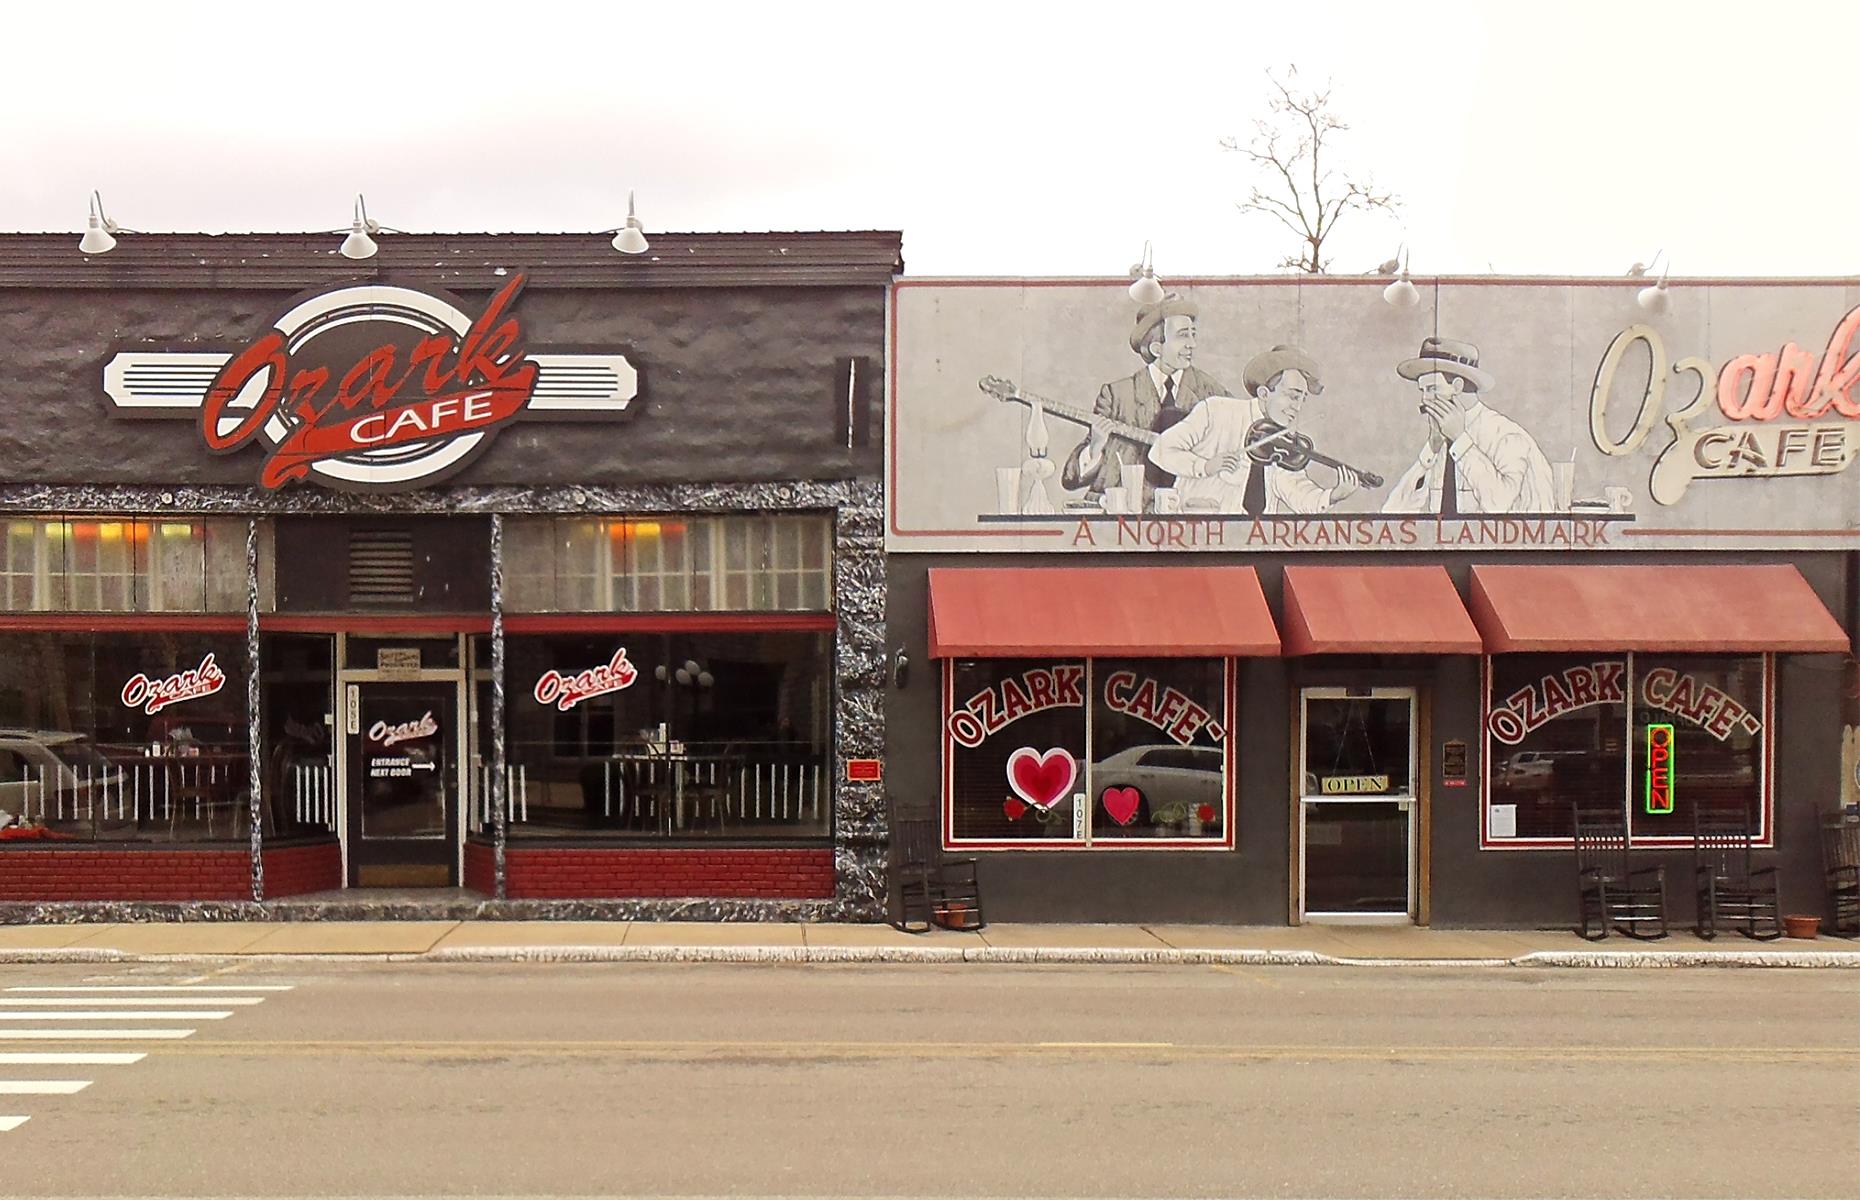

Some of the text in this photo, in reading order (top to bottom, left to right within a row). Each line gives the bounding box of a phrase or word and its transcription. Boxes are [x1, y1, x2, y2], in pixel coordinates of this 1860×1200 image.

[203, 272, 537, 489] Ozark
[349, 391, 494, 444] CAFE
[1693, 427, 1847, 470] CAFE
[1072, 514, 1611, 549] A NORTH ARKANSAS LANDMARK
[121, 652, 226, 715] Ozark
[534, 647, 638, 711] Ozark
[1488, 661, 1624, 745] OZARK
[369, 710, 438, 747] Ozark
[948, 665, 1084, 748] OZARK
[370, 767, 412, 777] NEXT DOOR
[371, 757, 410, 767] ENTRANCE
[1327, 777, 1383, 792] OPEN
[1651, 726, 1671, 809] OPEN
